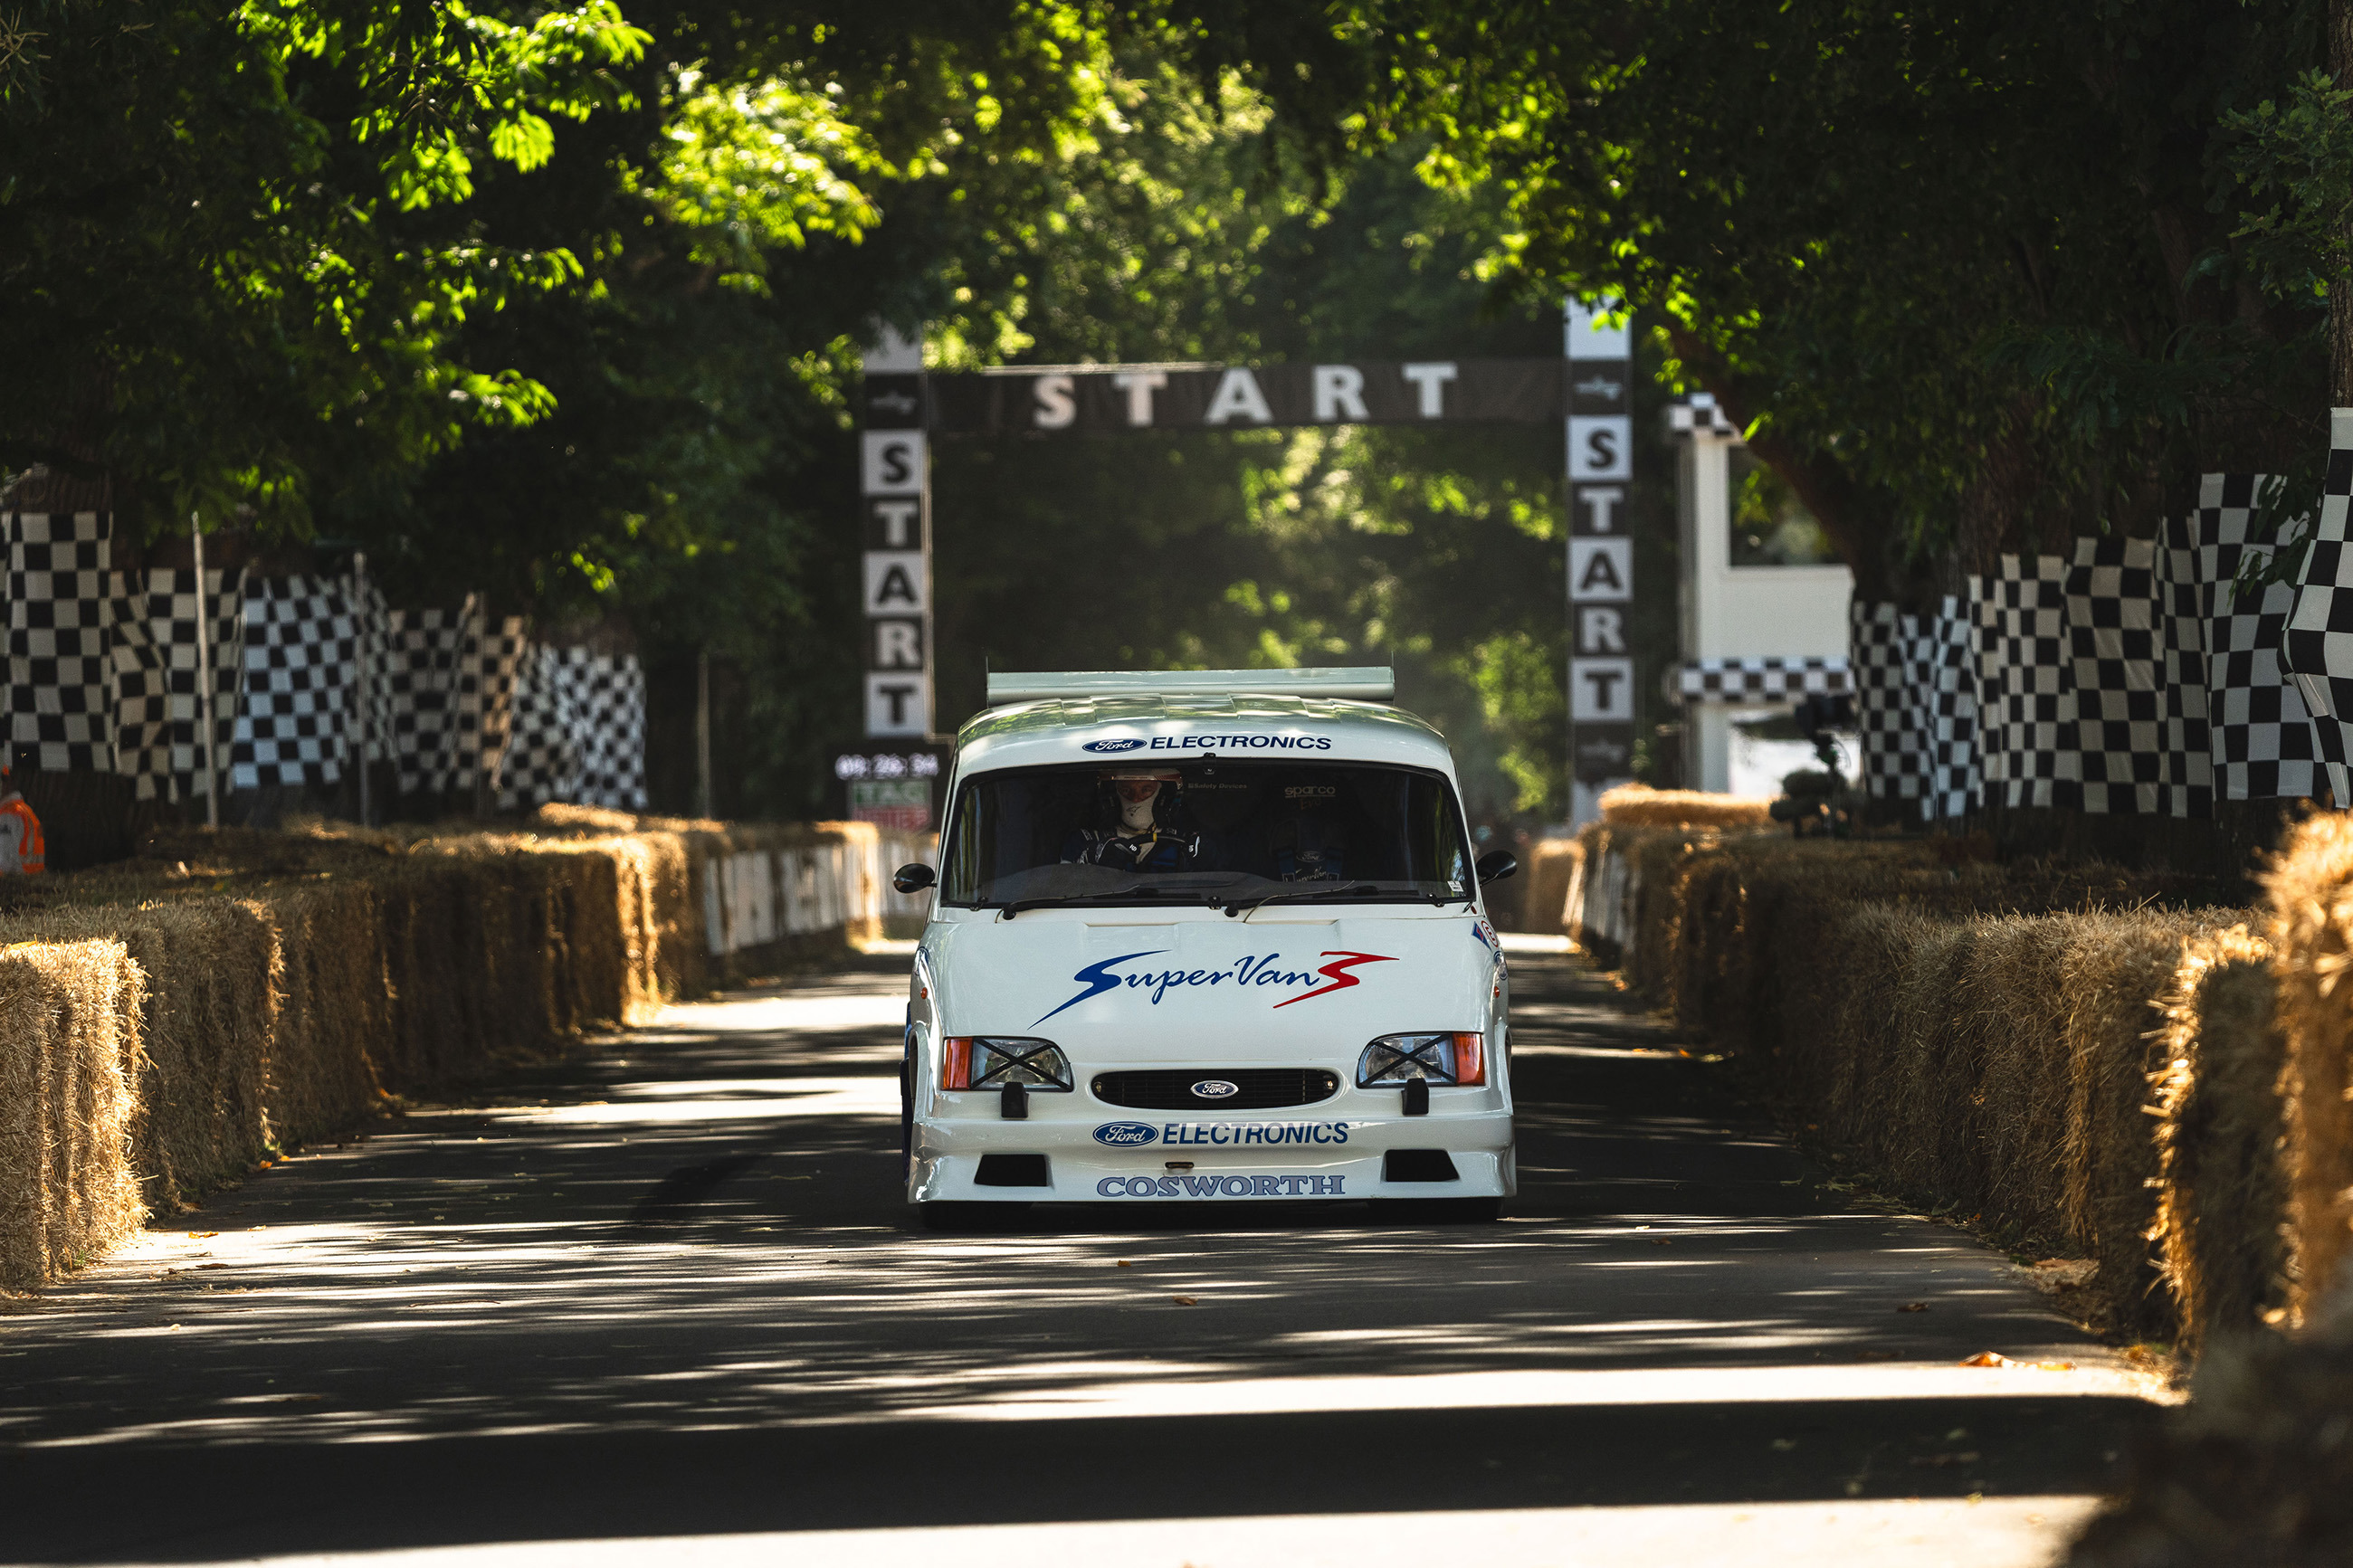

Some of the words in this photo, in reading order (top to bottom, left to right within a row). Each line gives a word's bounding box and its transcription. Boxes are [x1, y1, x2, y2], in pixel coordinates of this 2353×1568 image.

[1033, 363, 1458, 429] START
[1577, 428, 1625, 712] START
[873, 441, 921, 727] START
[1150, 736, 1332, 750] ELECTRONICS
[1284, 785, 1336, 798] sparco
[1162, 1122, 1349, 1145] ELECTRONICS
[1096, 1175, 1347, 1197] COSWORTH
